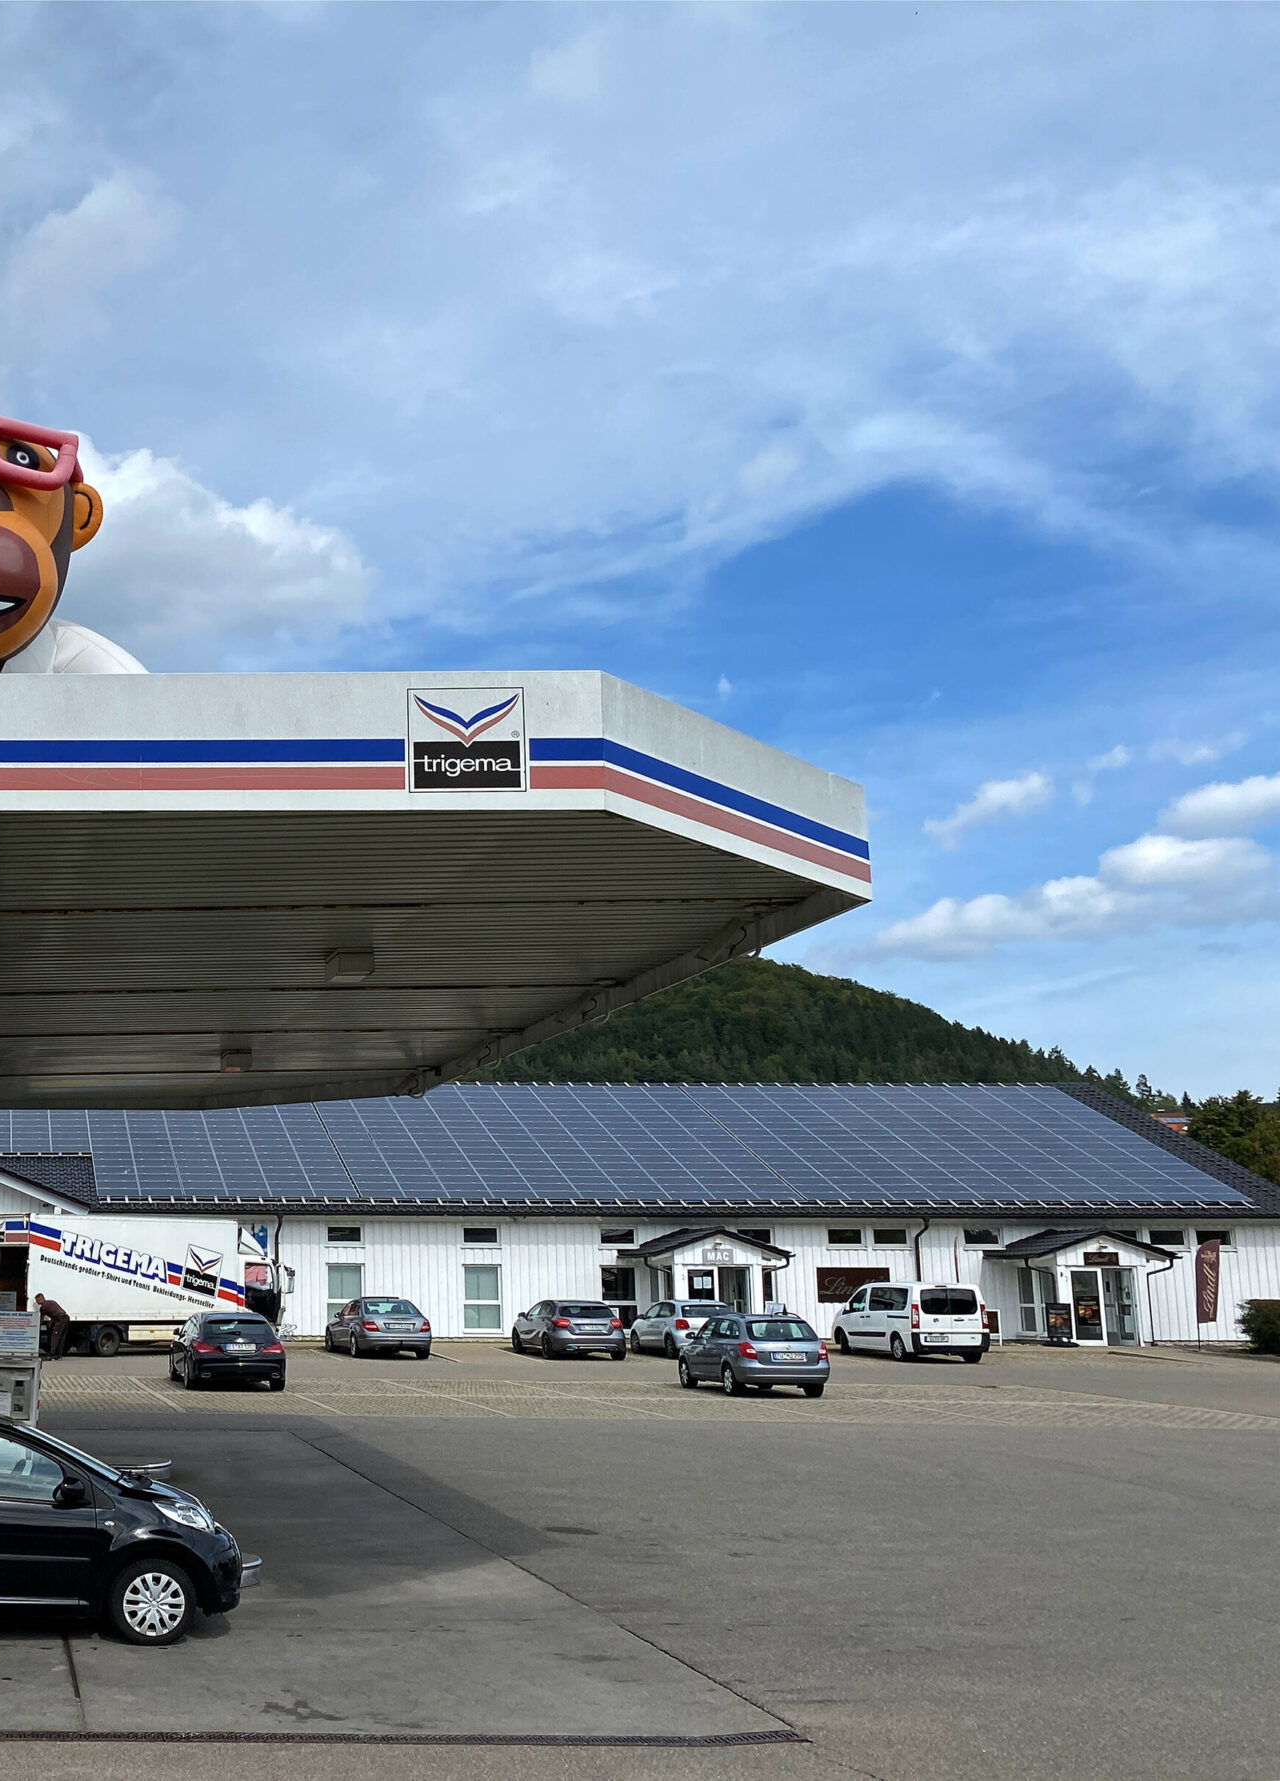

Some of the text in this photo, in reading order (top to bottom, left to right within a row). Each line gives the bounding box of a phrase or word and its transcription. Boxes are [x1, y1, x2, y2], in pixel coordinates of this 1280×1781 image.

[417, 754, 517, 777] trigema
[61, 1230, 168, 1284] TRIGEMA
[707, 1252, 730, 1261] MAC
[39, 1254, 215, 1309] Deutschlands größter T-Shirt und Tennis Bekleidungs- Hersteller
[186, 1273, 216, 1289] trigema
[1202, 1263, 1217, 1318] Lindt
